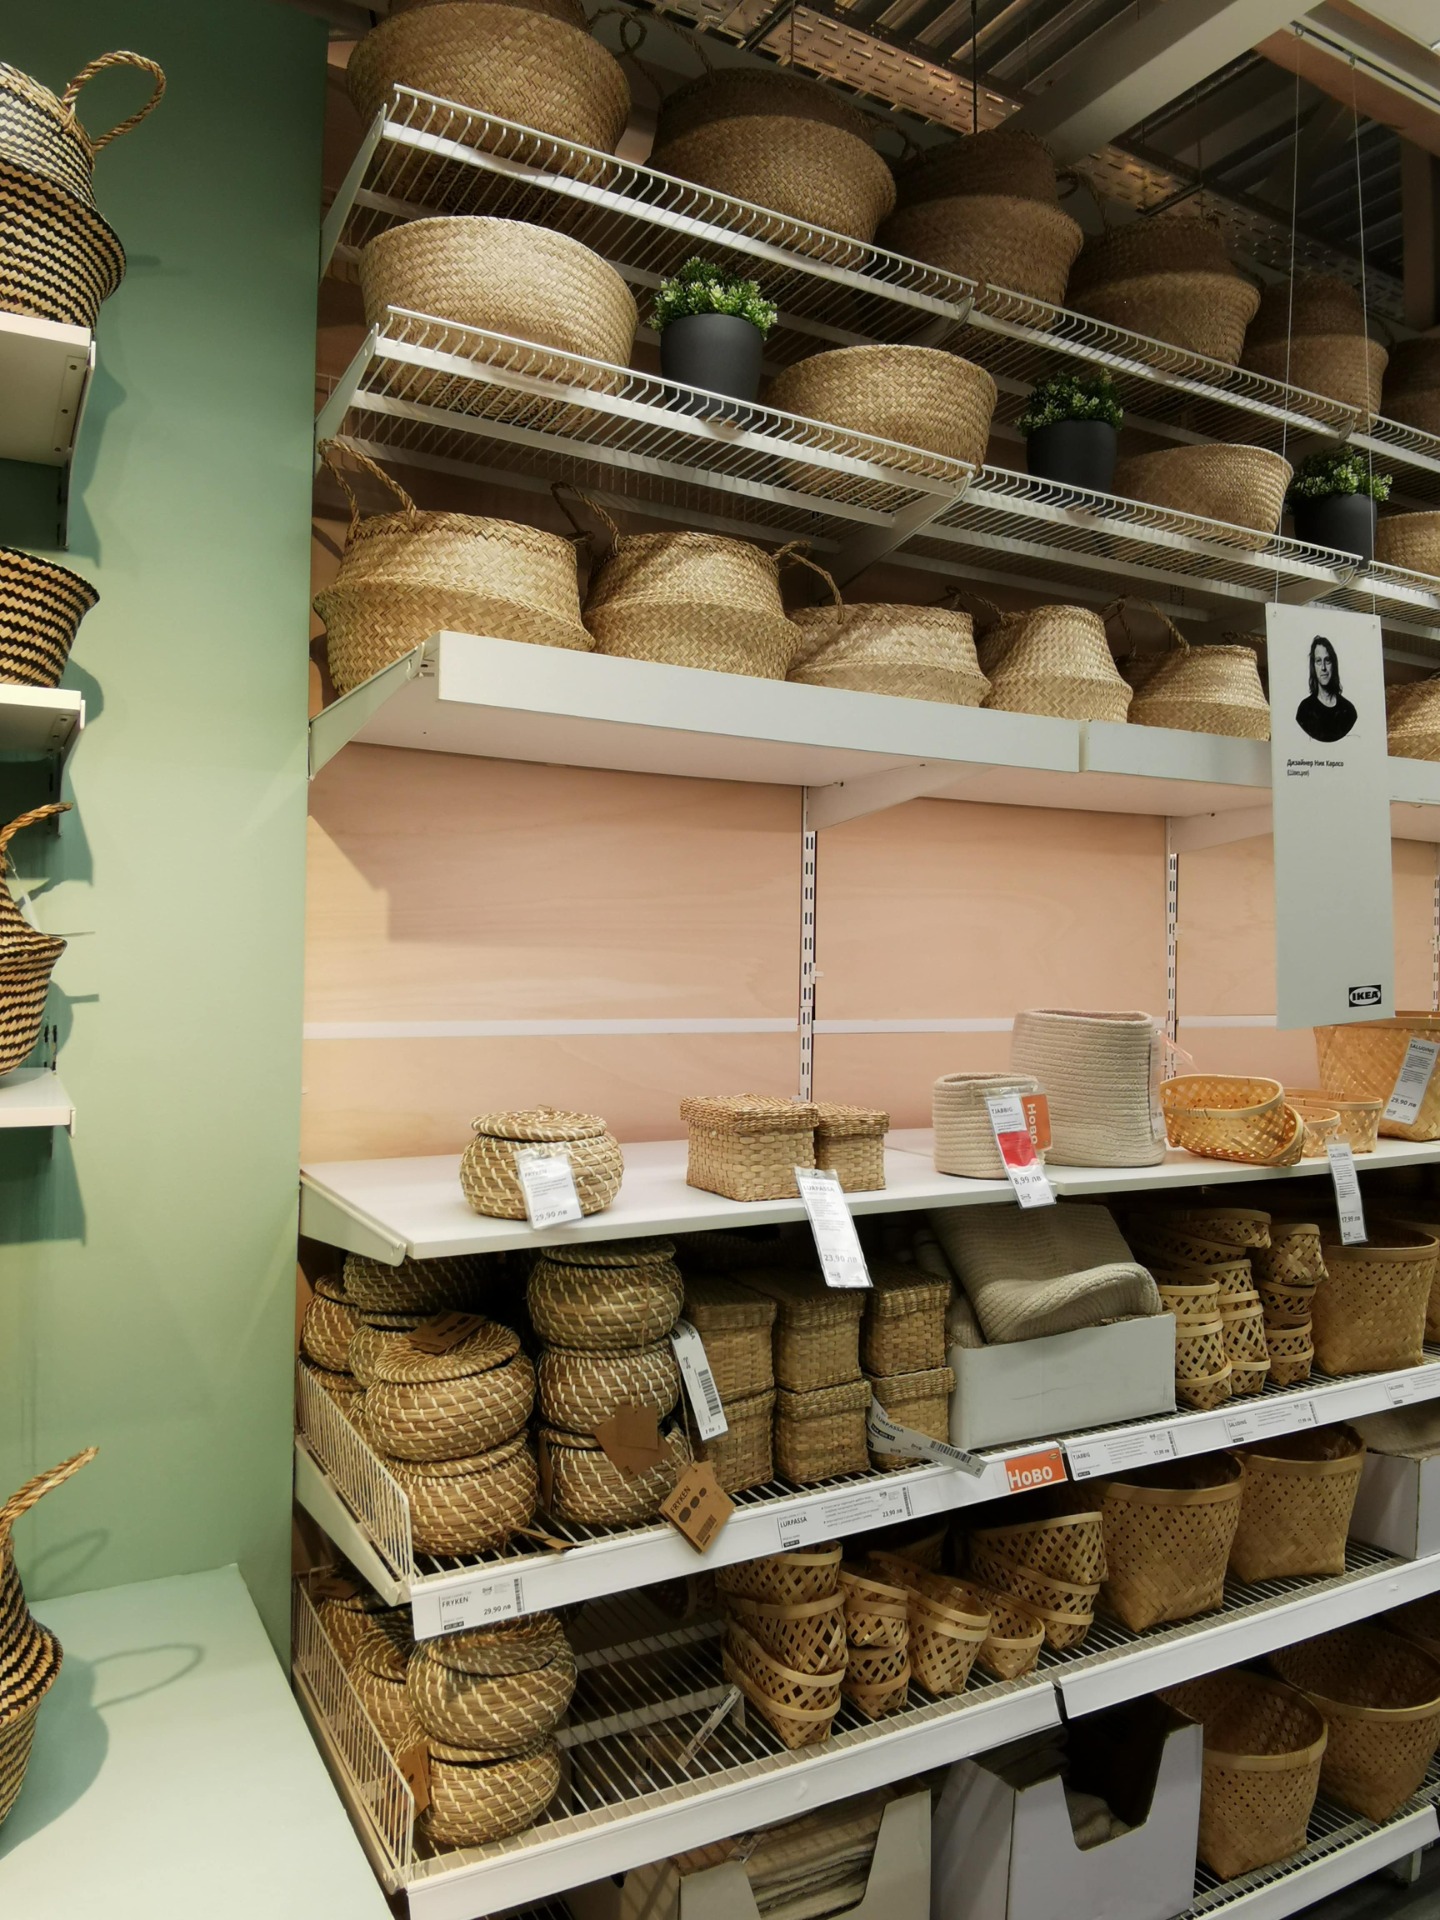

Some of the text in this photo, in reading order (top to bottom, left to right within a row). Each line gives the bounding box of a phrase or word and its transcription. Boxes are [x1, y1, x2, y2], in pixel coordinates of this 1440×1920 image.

[1352, 990, 1379, 1001] IKEA
[670, 1485, 691, 1514] FRYKEN
[780, 1516, 808, 1528] LURPASSA
[442, 1596, 469, 1608] FRYKEN
[483, 1605, 502, 1616] 29,90
